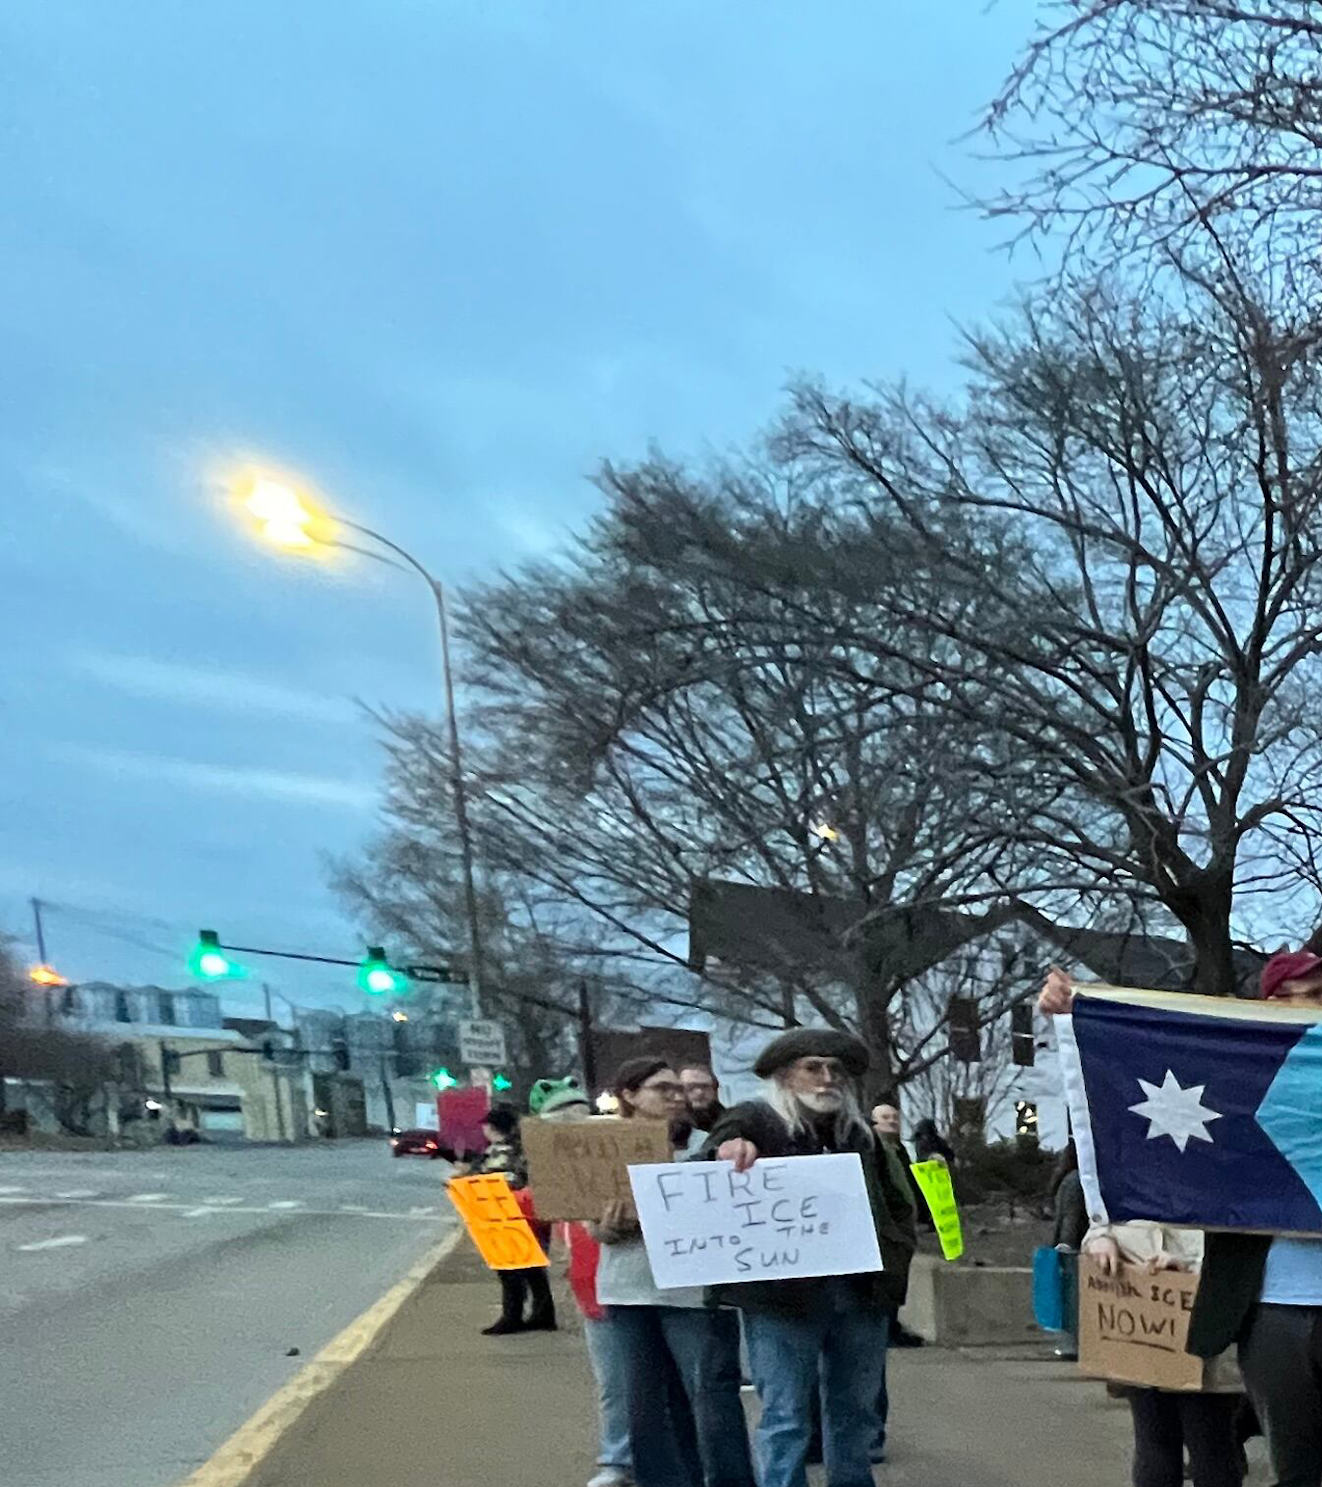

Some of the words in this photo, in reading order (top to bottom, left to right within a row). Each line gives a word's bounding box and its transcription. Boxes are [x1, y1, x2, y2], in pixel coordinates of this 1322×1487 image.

[656, 1163, 788, 1213] FIRE
[733, 1195, 819, 1229] ICE
[664, 1234, 742, 1257] INTO
[776, 1222, 830, 1239] THE
[734, 1246, 800, 1272] SUN
[1150, 1284, 1194, 1312] ICE
